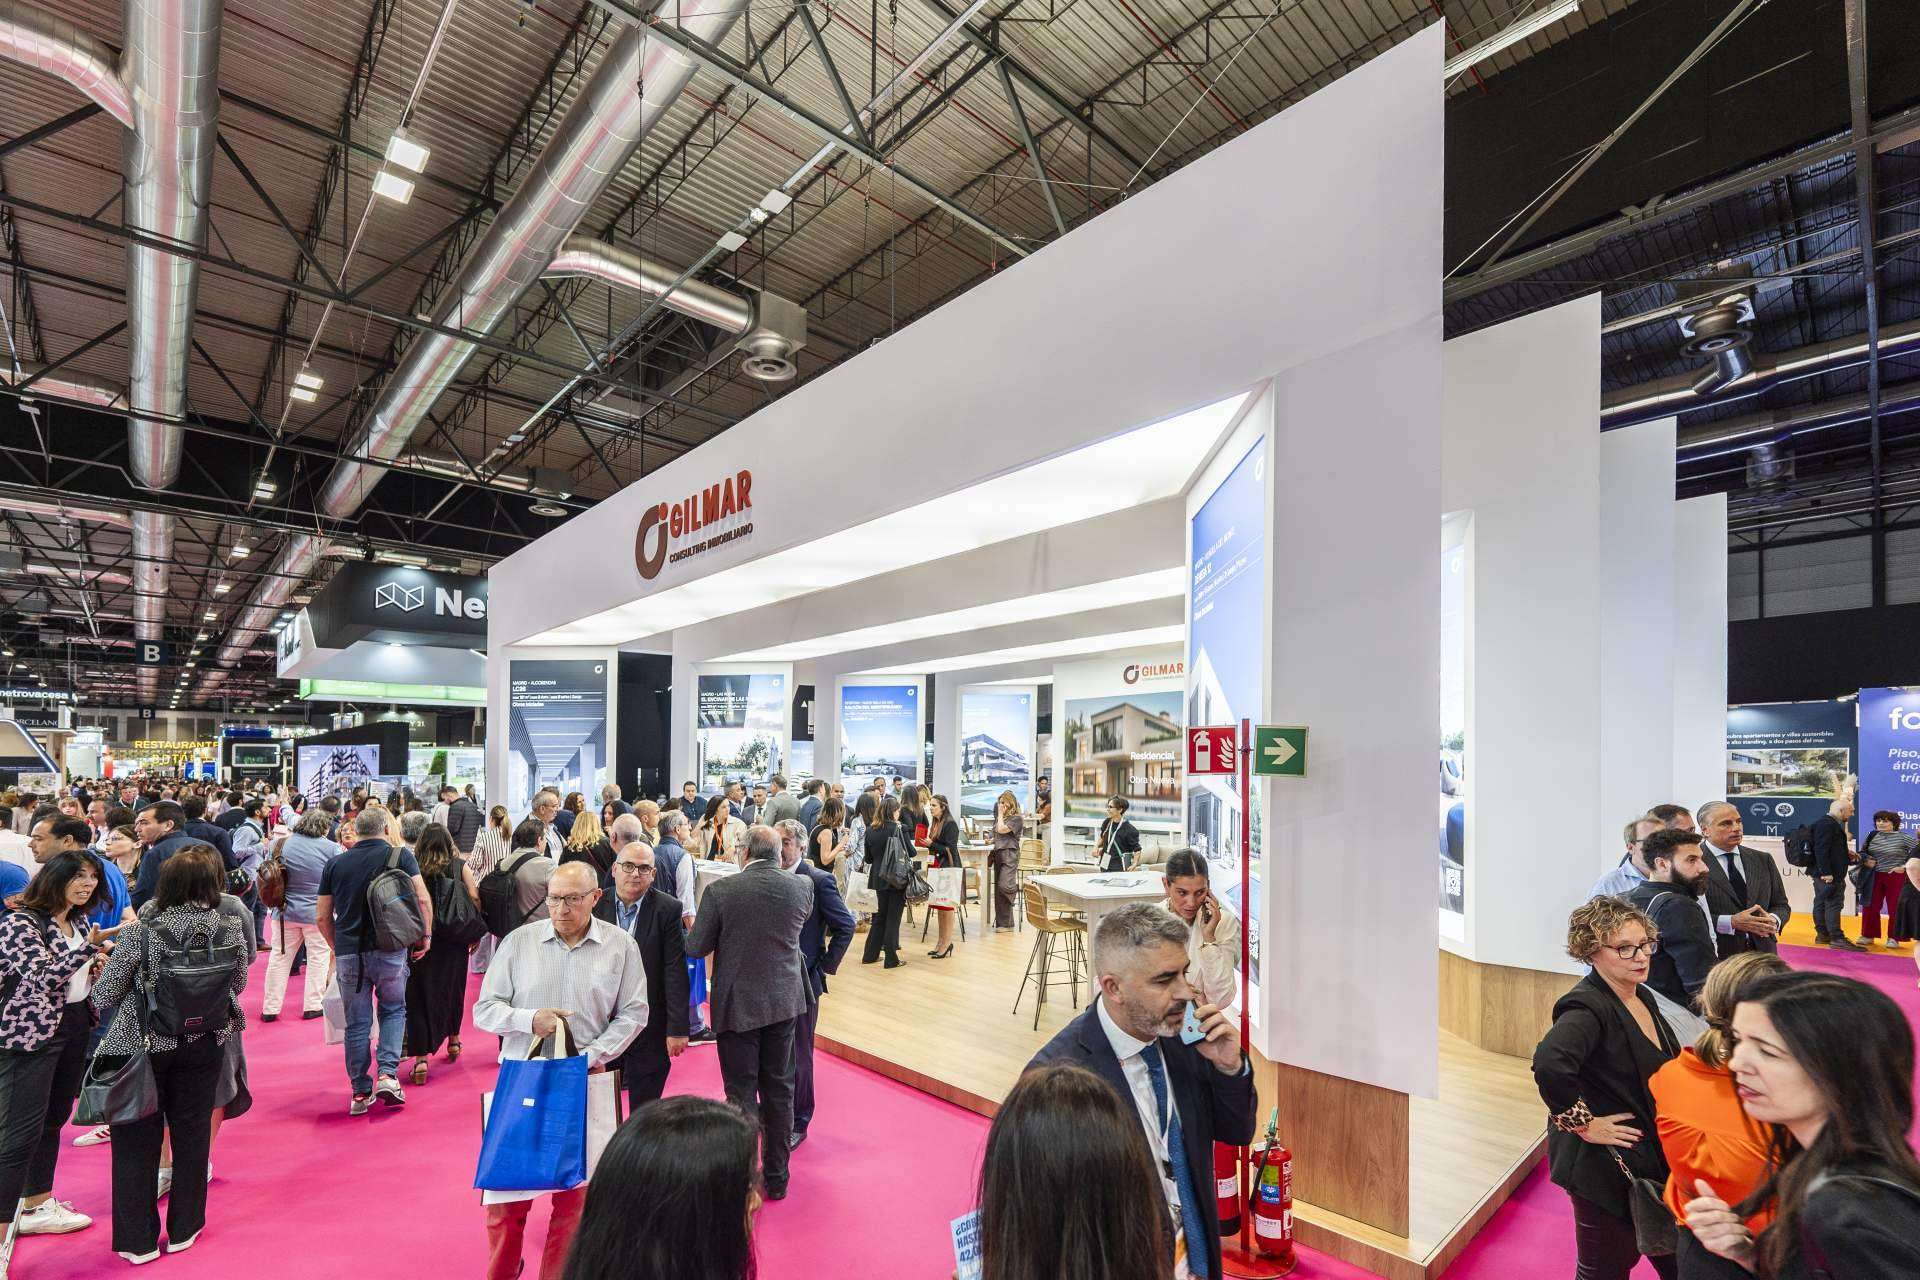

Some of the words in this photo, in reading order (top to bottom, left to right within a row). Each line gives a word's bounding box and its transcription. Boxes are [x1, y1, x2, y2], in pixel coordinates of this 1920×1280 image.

[669, 470, 753, 538] GILMAR
[669, 541, 707, 563] CONSULTING
[707, 523, 754, 549] INMOBILIARIO
[435, 586, 488, 619] Ne
[144, 645, 161, 662] B
[1141, 662, 1184, 677] GILMAR
[142, 709, 152, 718] B
[1130, 751, 1175, 760] Residencial
[1893, 760, 1920, 770] átic
[1129, 775, 1149, 785] Obra
[1150, 776, 1176, 785] Nueva
[1897, 811, 1920, 820] Bus
[956, 1217, 979, 1236] ¿COB
[957, 1231, 980, 1249] HAST
